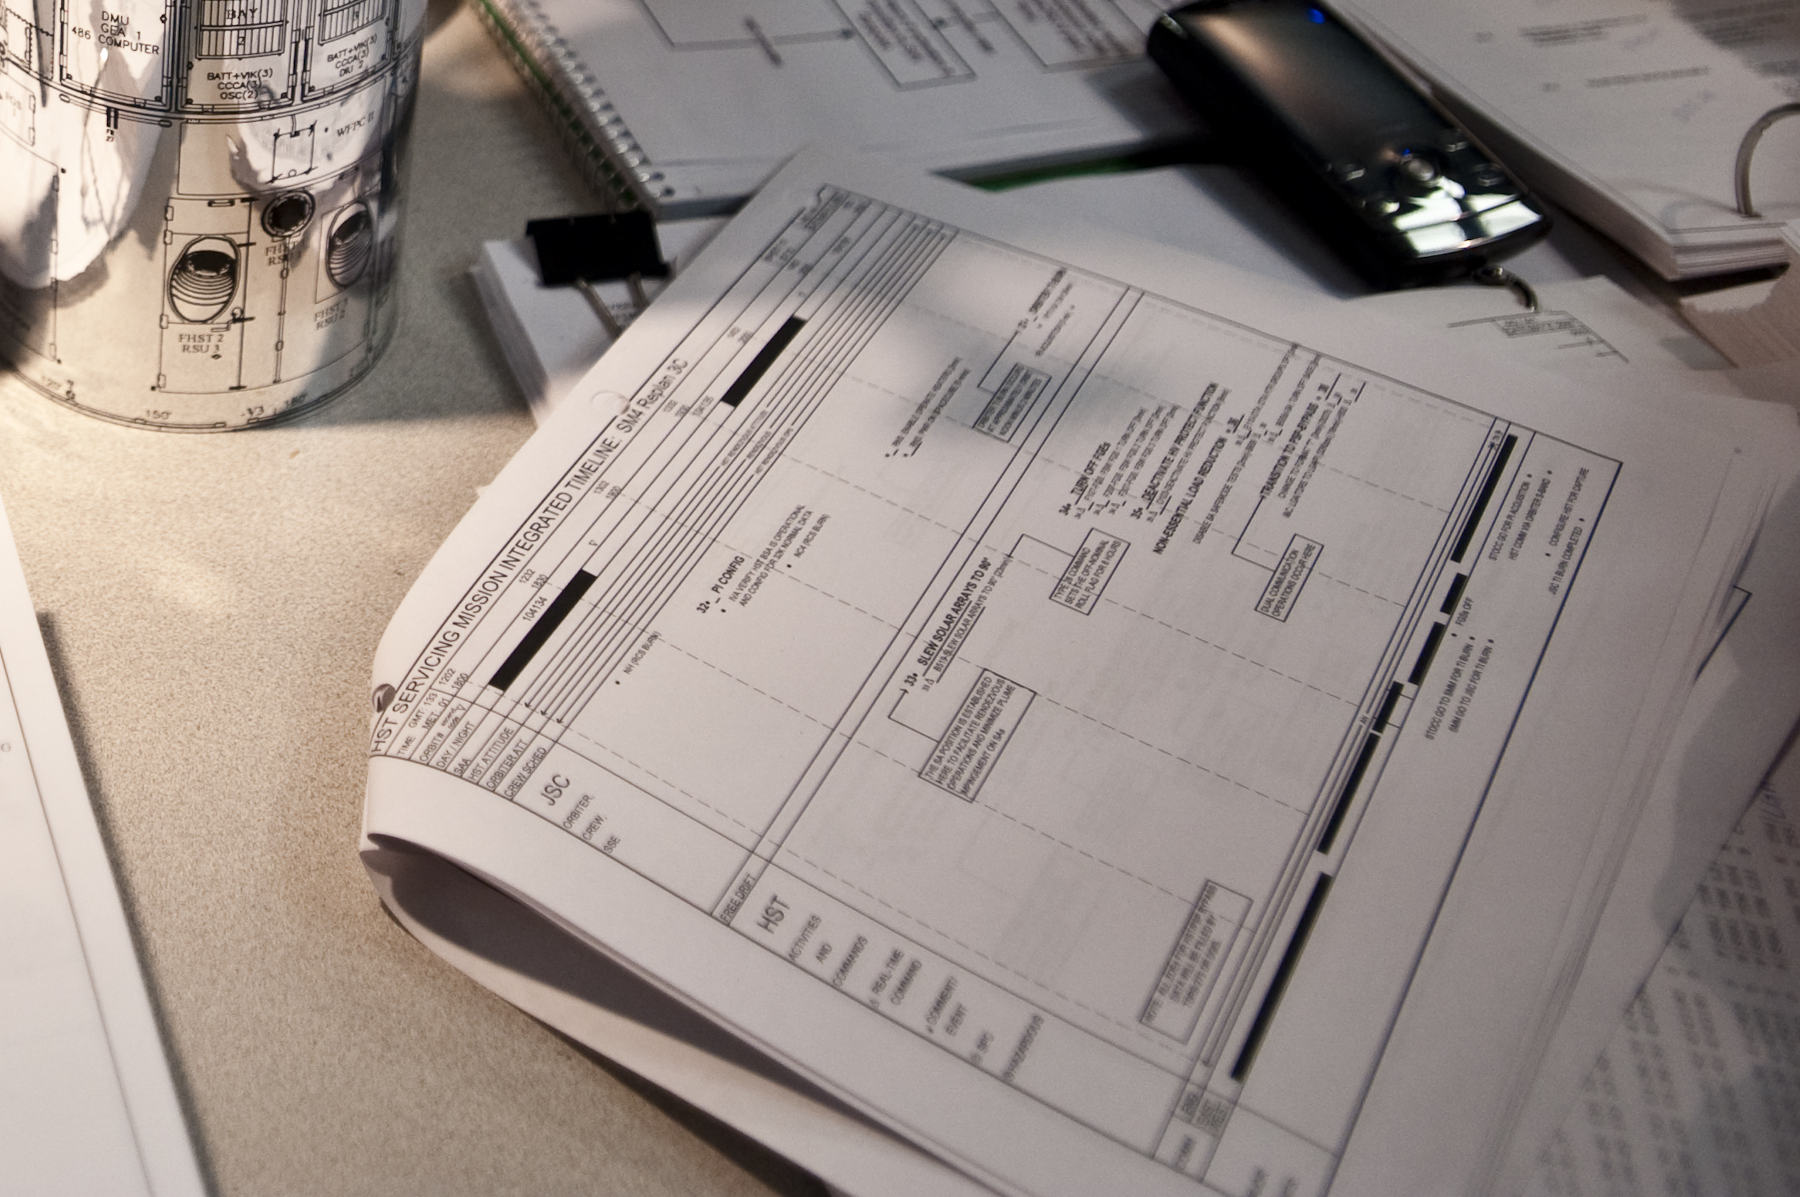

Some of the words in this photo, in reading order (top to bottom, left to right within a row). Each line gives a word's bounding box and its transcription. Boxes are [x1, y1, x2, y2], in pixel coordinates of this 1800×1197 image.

[100, 22, 126, 36] GEA
[101, 10, 129, 25] DMU
[71, 26, 91, 39] 486
[97, 34, 159, 54] COMPUTER
[178, 333, 214, 344] FHST
[215, 333, 224, 342] 2
[181, 343, 210, 353] RSU
[213, 343, 220, 352] 3
[370, 715, 399, 756] HST
[392, 629, 462, 714] SERVICING
[455, 570, 509, 630] MISSION
[498, 491, 573, 577] INTEGRATED
[565, 437, 622, 491] TIMELINE:
[615, 405, 645, 434] SM4
[666, 358, 689, 376] 3C
[717, 555, 746, 585] CONFIG
[917, 640, 939, 667] SLEW
[932, 613, 958, 644] SOLAR
[950, 581, 978, 616] ARRAYS
[970, 569, 985, 582] TO
[423, 692, 439, 706] 133
[438, 667, 457, 685] 1202
[396, 735, 416, 756] TIME
[467, 762, 485, 783] HST
[481, 726, 514, 766] ATTITUDE
[453, 758, 472, 776] SAA
[540, 774, 571, 807] JSC
[562, 794, 593, 831] ORBITER,
[602, 835, 621, 854] SSE
[756, 894, 790, 935] HST
